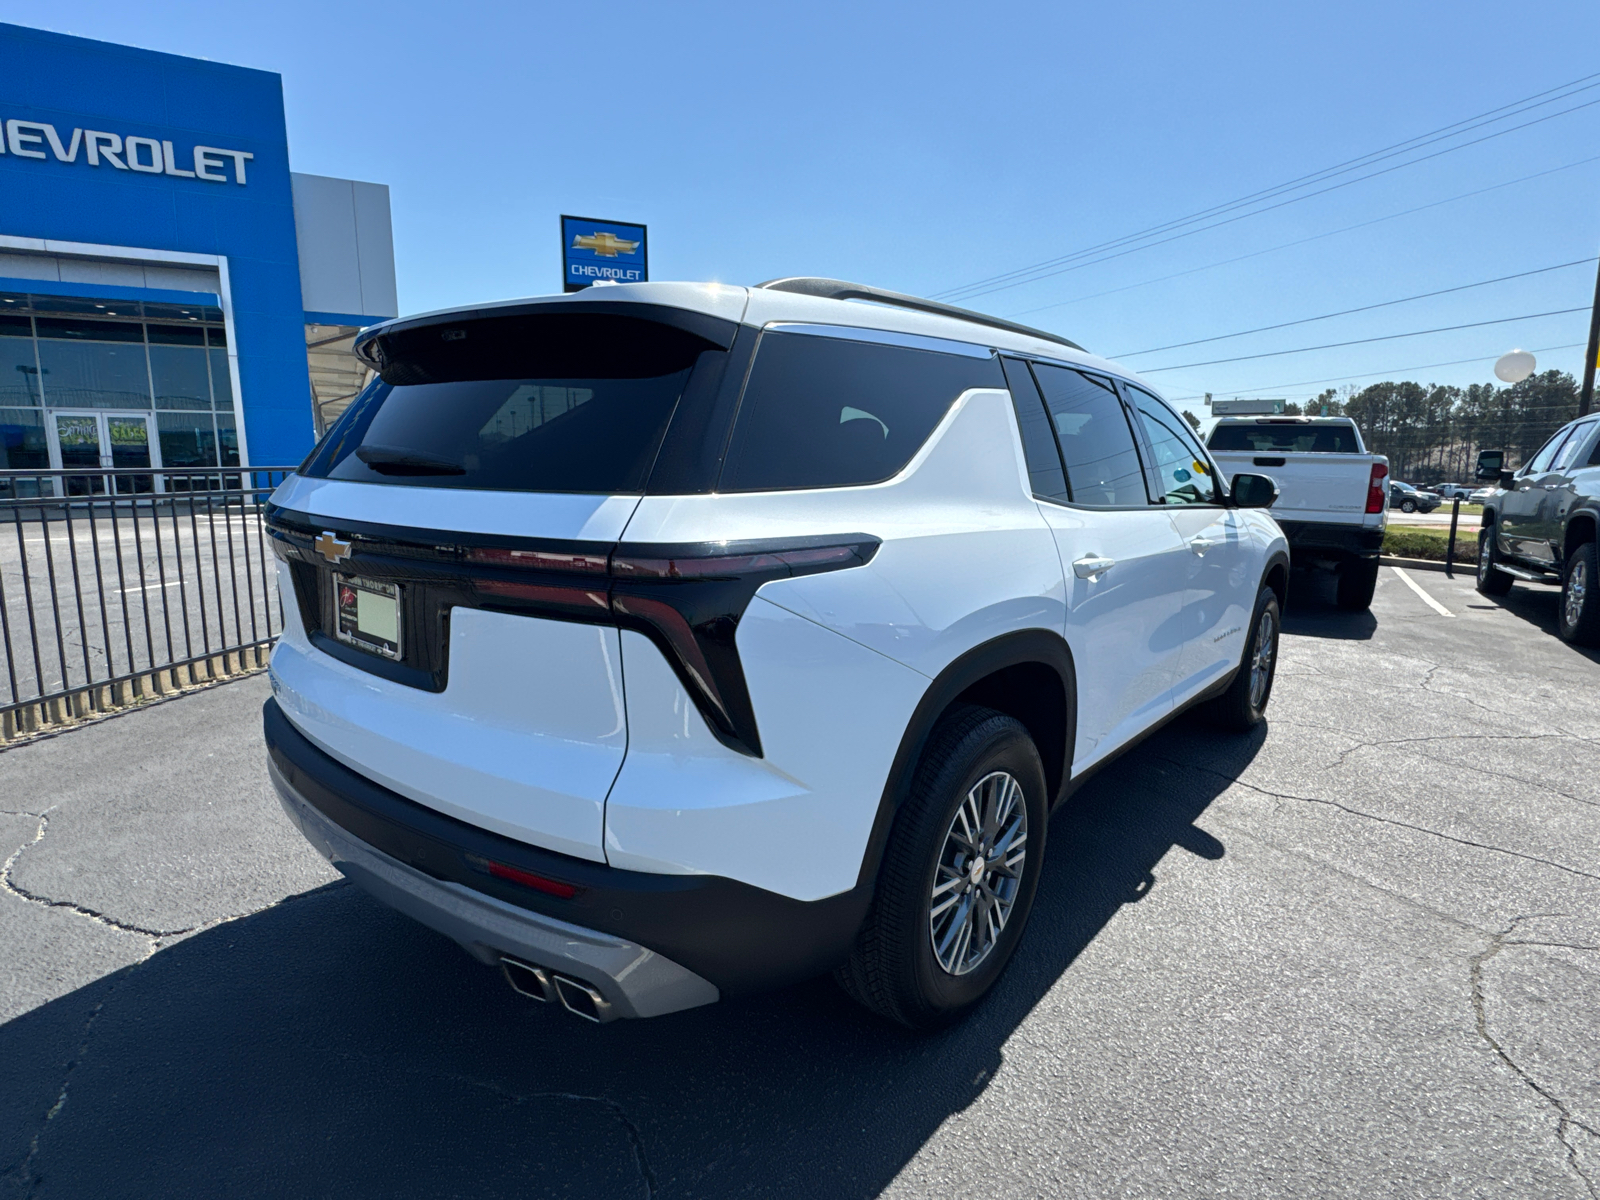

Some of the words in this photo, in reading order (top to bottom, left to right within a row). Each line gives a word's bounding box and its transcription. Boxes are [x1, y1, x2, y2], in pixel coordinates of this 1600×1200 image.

[0, 118, 254, 185] EVROLET
[571, 264, 641, 280] CHEVROLET
[112, 427, 147, 441] SALES
